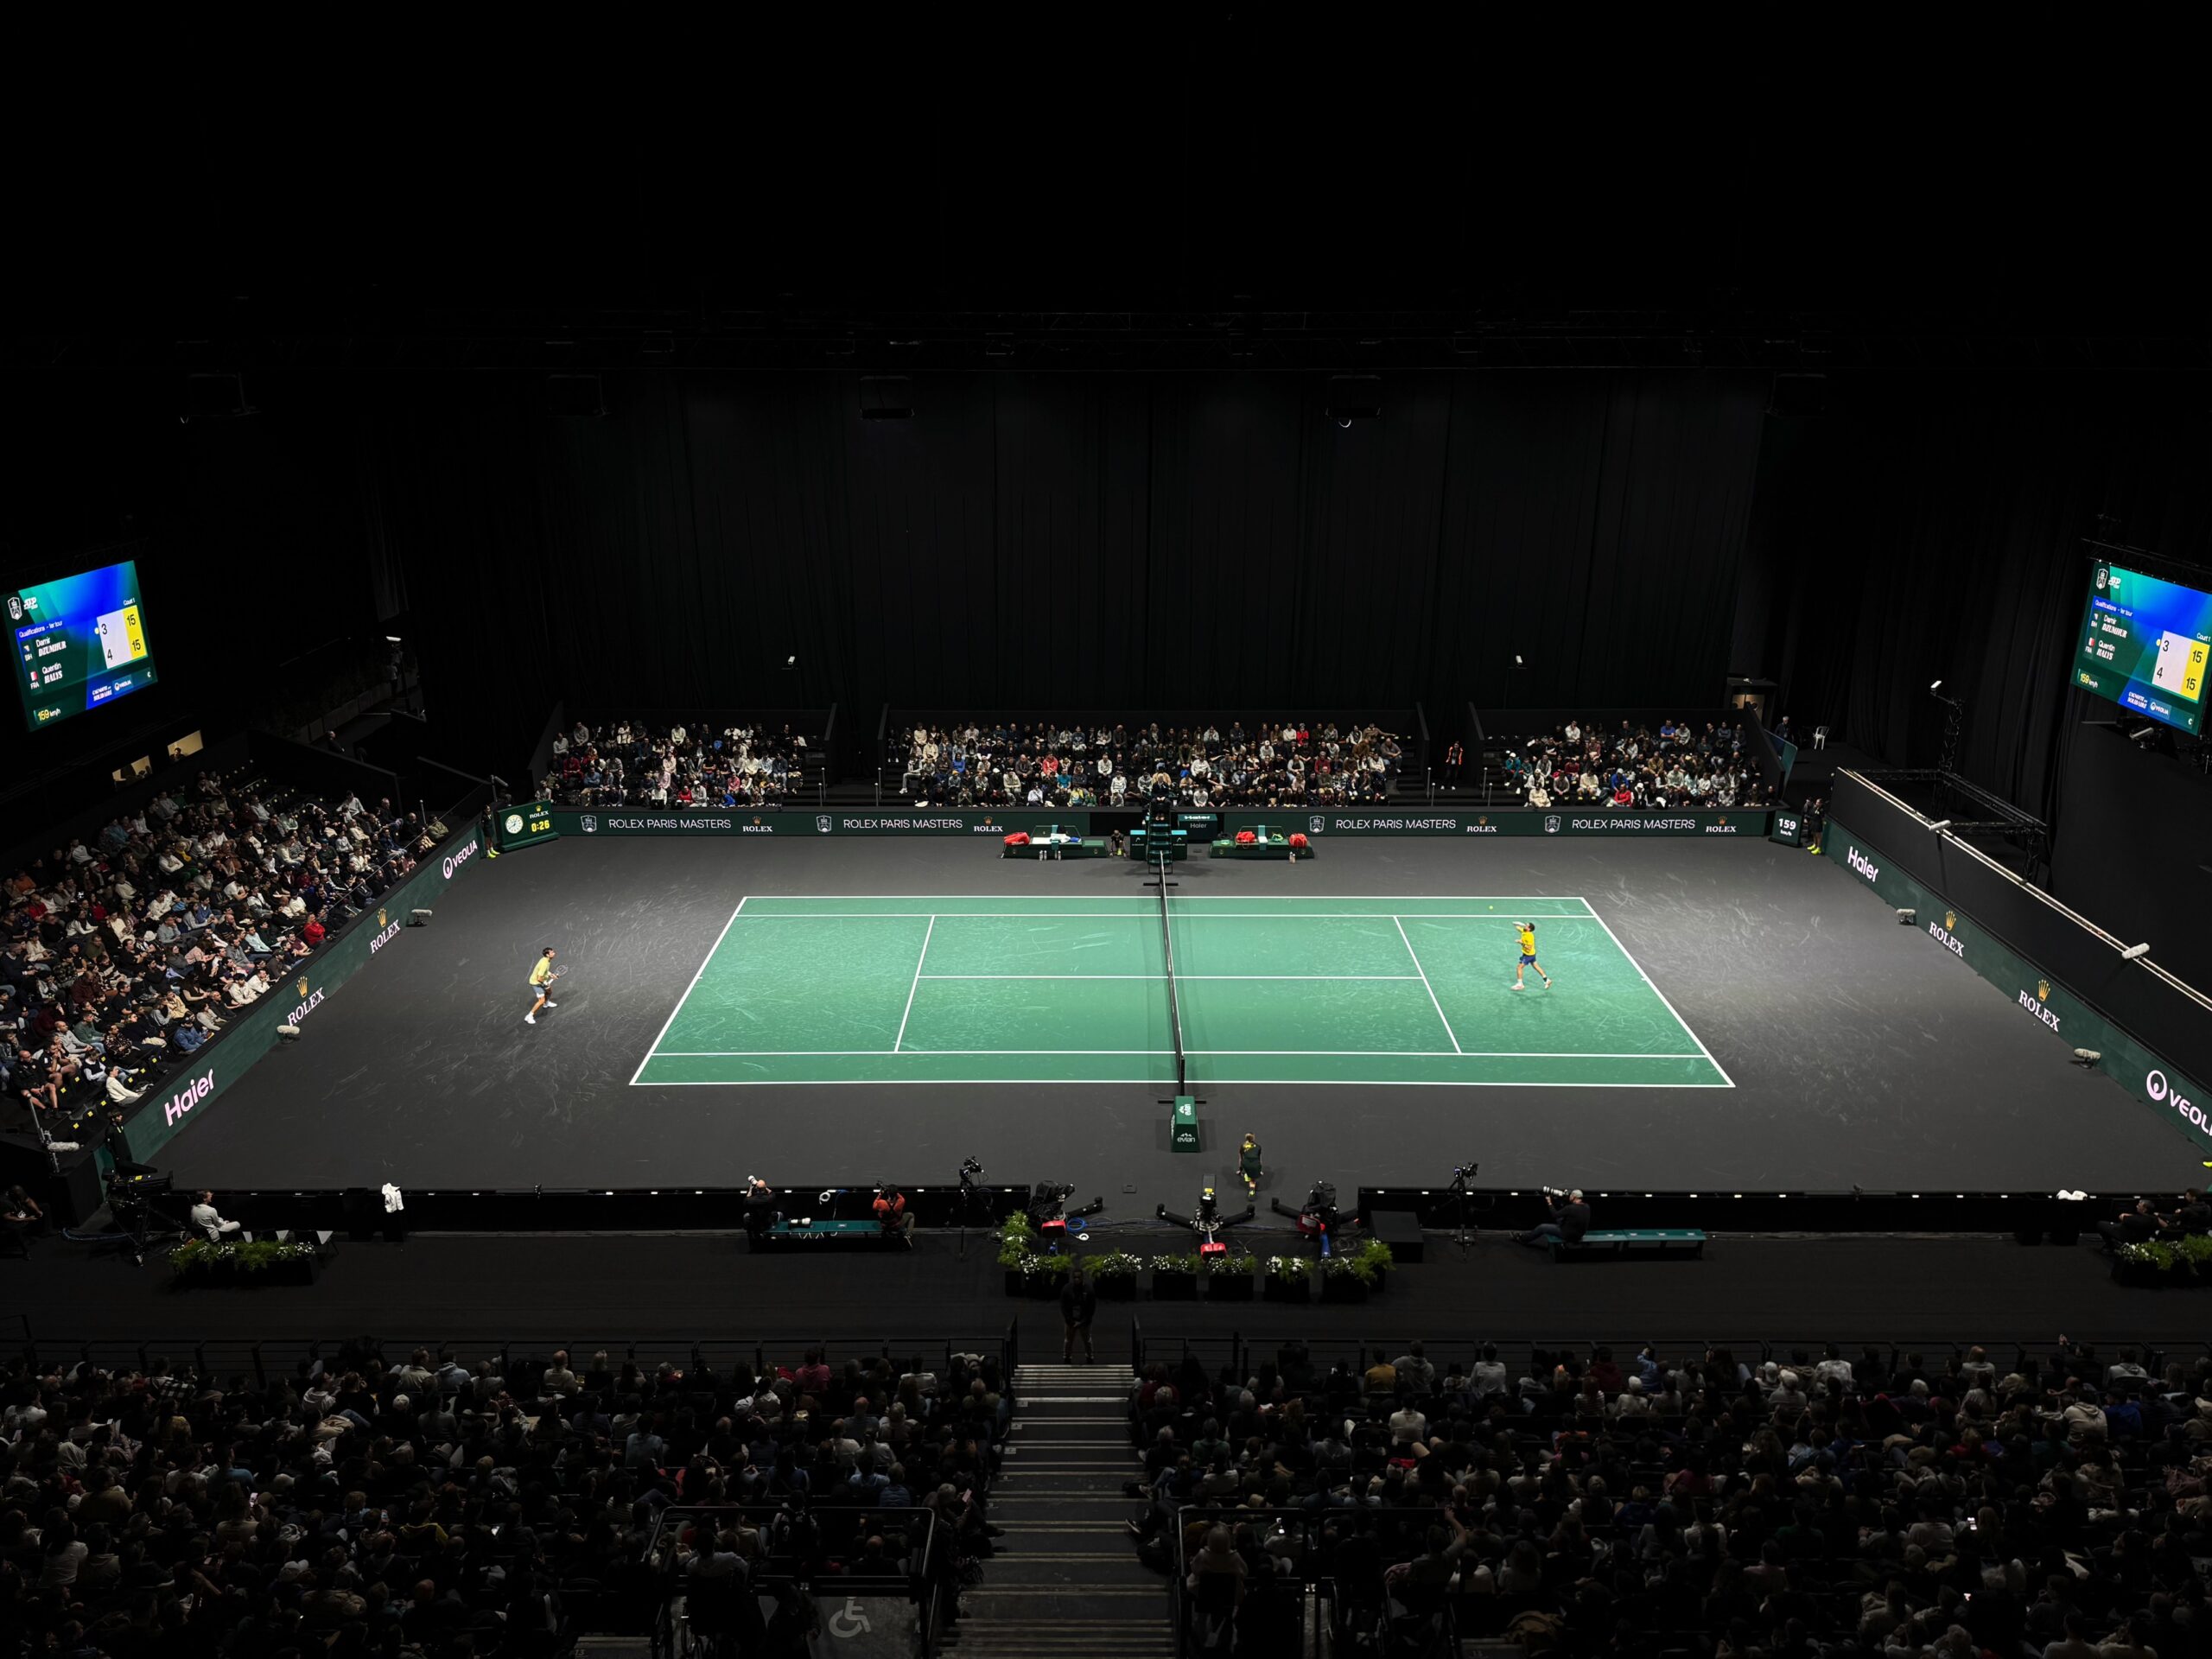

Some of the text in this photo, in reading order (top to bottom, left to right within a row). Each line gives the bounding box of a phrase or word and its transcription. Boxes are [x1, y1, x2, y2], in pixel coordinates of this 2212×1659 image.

[127, 613, 137, 626] 15
[19, 626, 45, 638] Qualifications
[101, 623, 108, 635] 3
[36, 637, 50, 647] Damir
[132, 639, 142, 652] 15
[2098, 639, 2115, 652] Quentin
[2163, 639, 2170, 652] 3
[107, 649, 113, 661] 4
[2192, 650, 2202, 664] 15
[41, 663, 61, 674] Quentin
[2156, 666, 2163, 679] 4
[2080, 673, 2090, 684] 159
[2186, 677, 2196, 691] 15
[30, 681, 40, 690] FRA
[37, 709, 50, 721] 159
[530, 810, 549, 818] ROLEX
[531, 820, 550, 832] 0:26
[609, 819, 644, 828] ROLEX
[647, 819, 677, 828] PARIS
[913, 819, 963, 828] MASTERS
[1337, 820, 1456, 829] ROLEX PARIS MASTERS
[1573, 820, 1694, 829] ROLEX PARIS MASTERS
[1778, 817, 1797, 830] 159
[452, 840, 477, 868] VEOLIA
[1848, 846, 1878, 882] Haier
[371, 919, 400, 953] ROLEX
[1929, 922, 1964, 957] ROLEX
[287, 988, 324, 1027] ROLEX
[2018, 990, 2060, 1032] ROLEX
[165, 1069, 213, 1126] Haier
